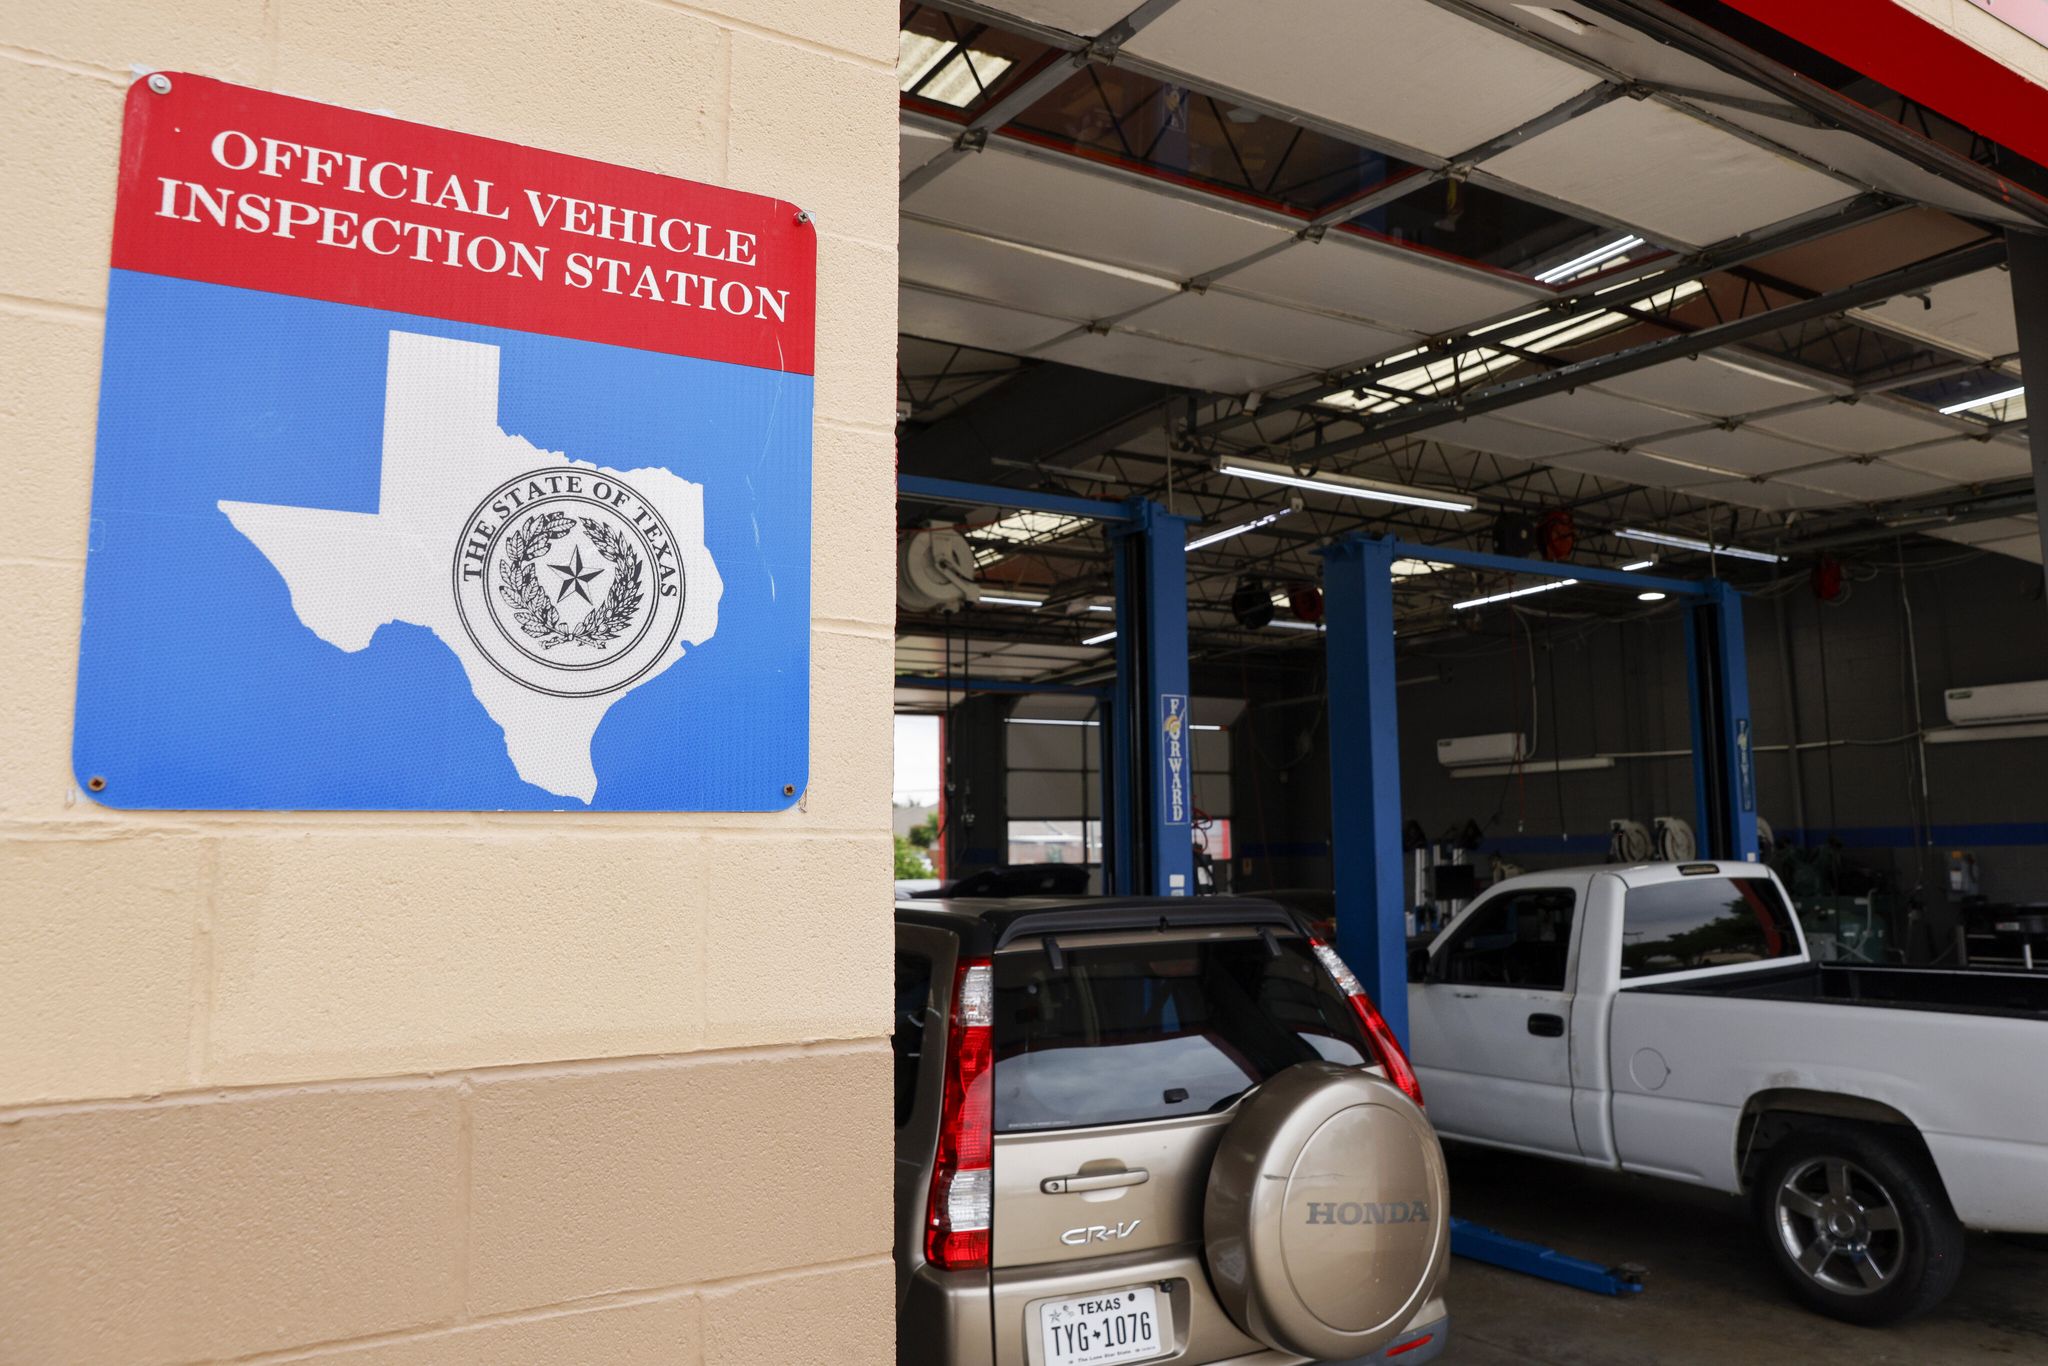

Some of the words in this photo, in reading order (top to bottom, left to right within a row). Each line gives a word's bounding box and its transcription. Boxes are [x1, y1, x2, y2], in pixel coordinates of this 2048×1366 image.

[211, 130, 509, 221] OFFICIAL
[524, 189, 757, 267] VEHICLE
[155, 176, 549, 282] INSPECTION
[564, 252, 791, 323] STATION
[463, 520, 496, 582] THE
[492, 475, 583, 520] STATE
[592, 481, 630, 508] OF
[633, 505, 677, 598] TEXAS
[1168, 698, 1184, 822] FORWARD
[1059, 1218, 1141, 1247] CR-V
[1305, 1202, 1430, 1226] HONDA
[1051, 1321, 1090, 1357] TYG
[1102, 1311, 1152, 1348] 1076
[1078, 1297, 1121, 1316] TEXAS
